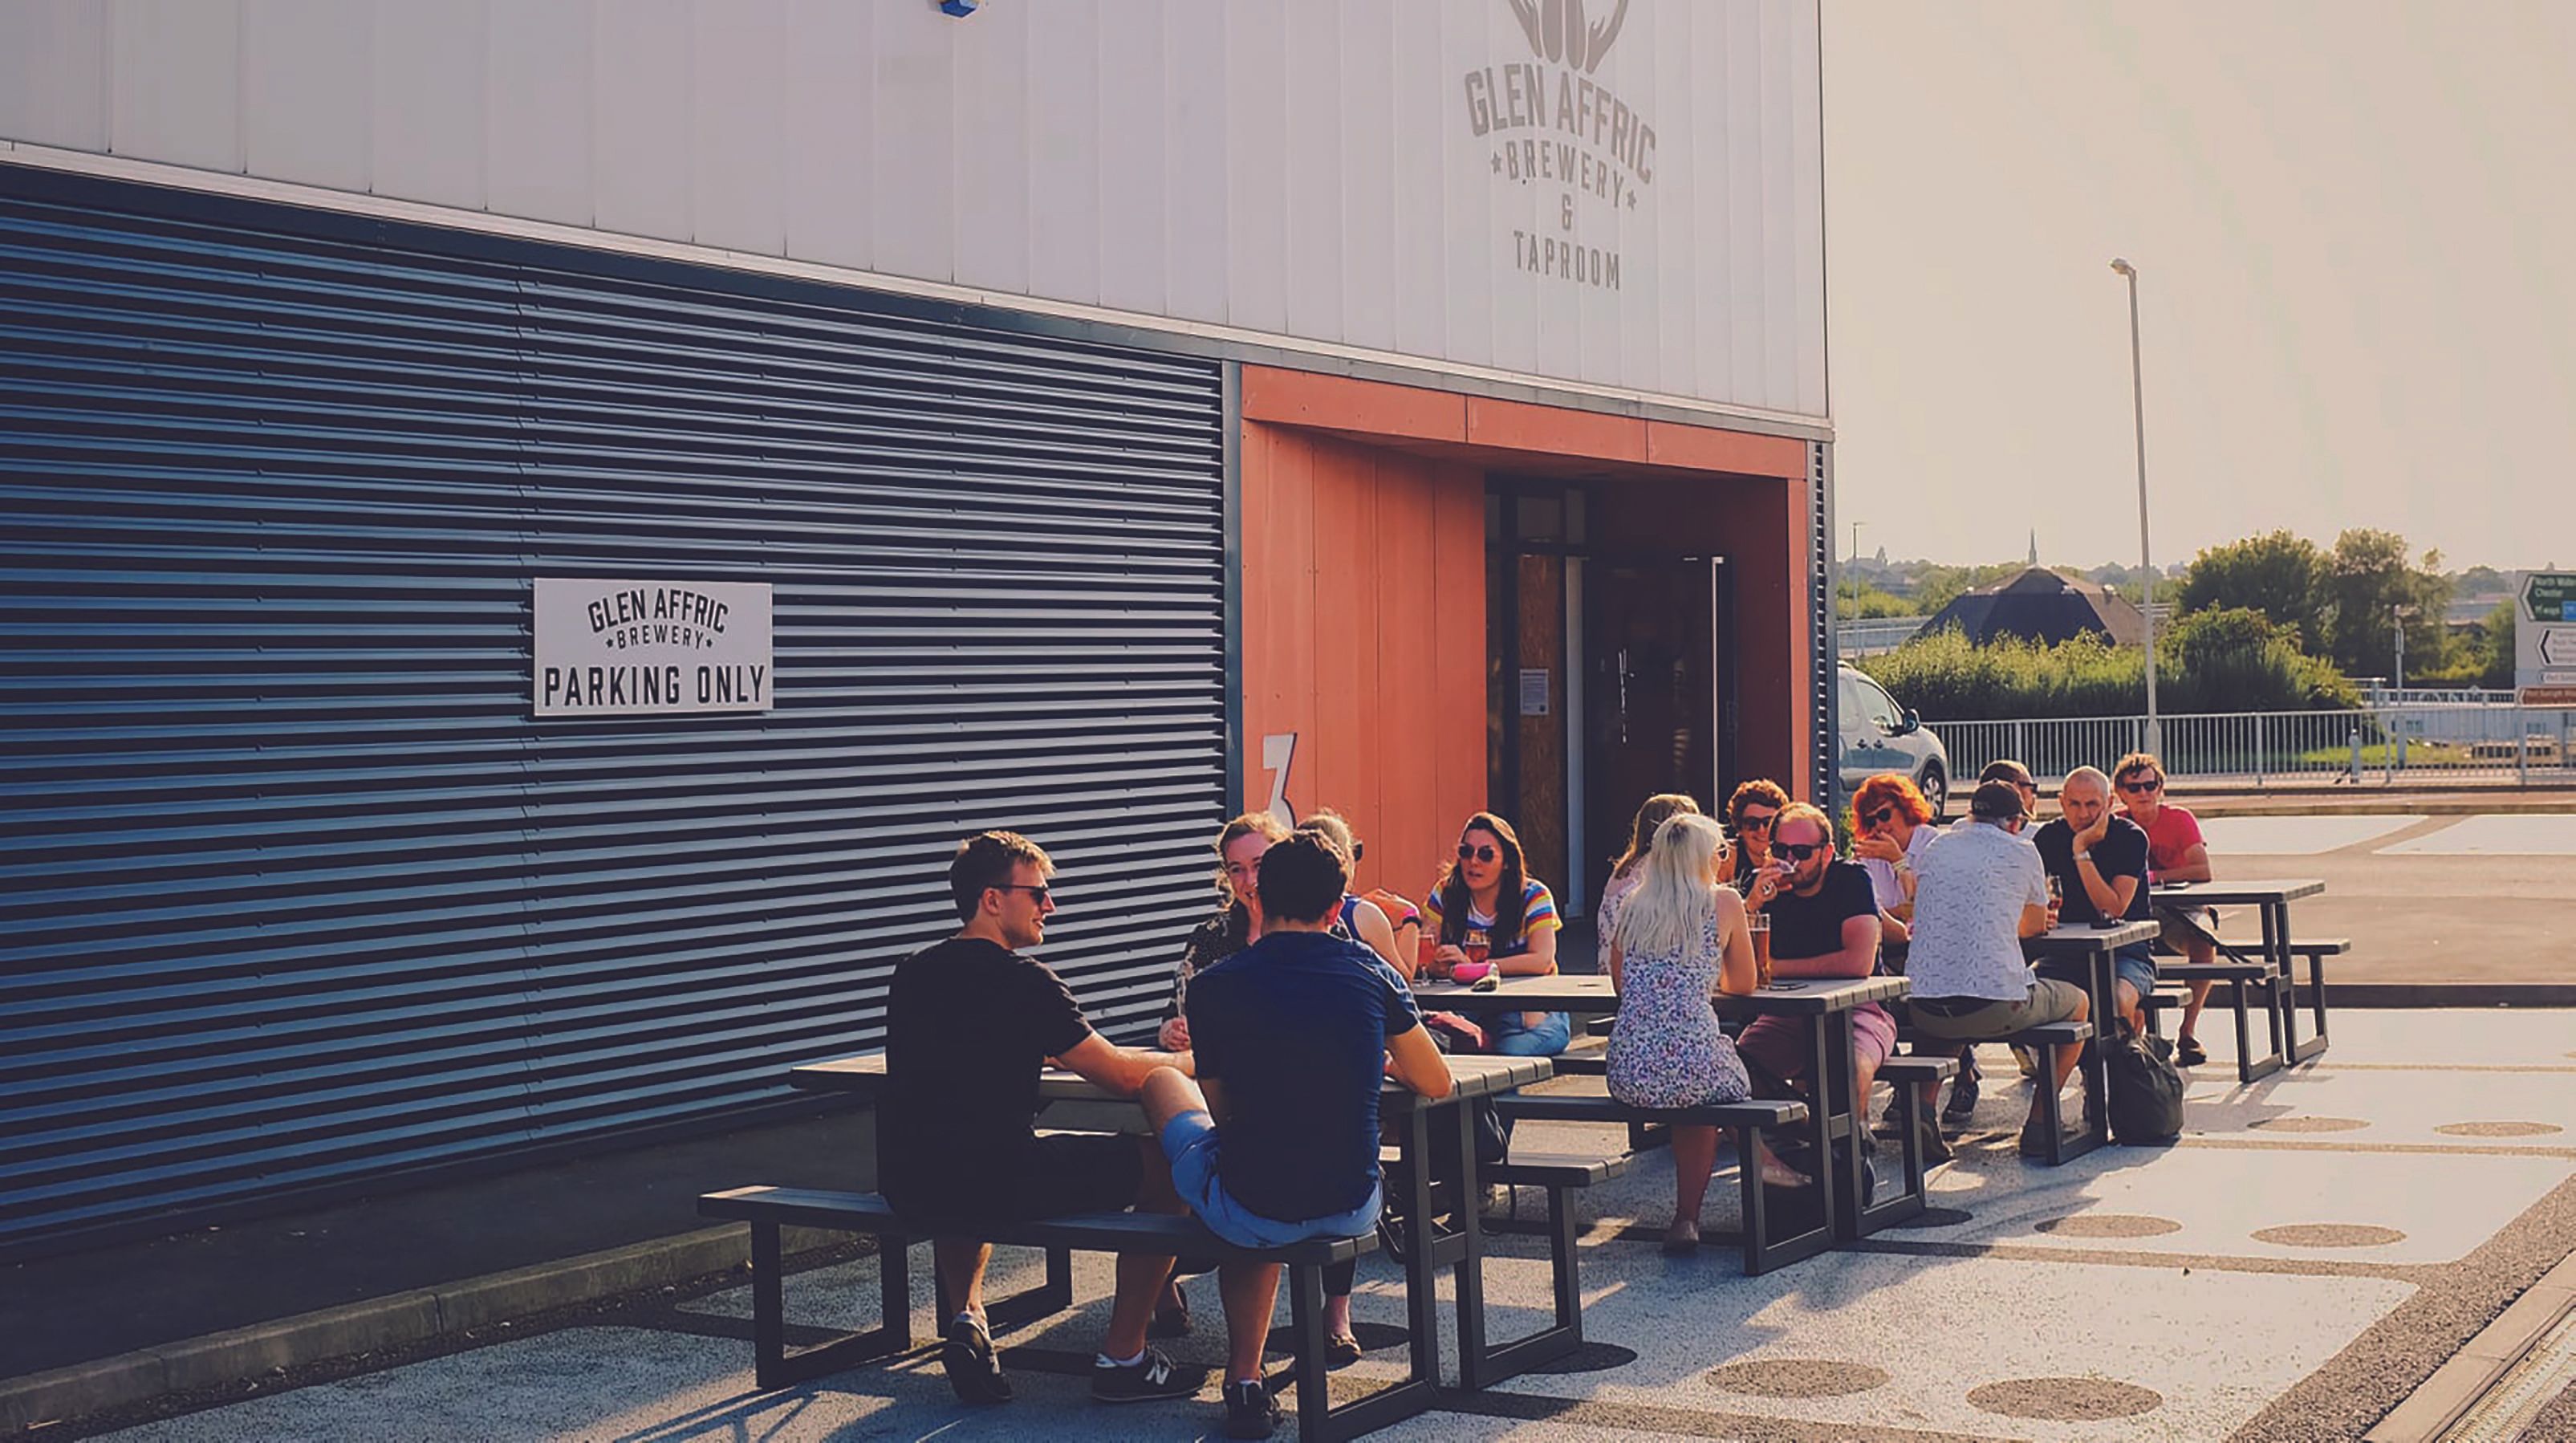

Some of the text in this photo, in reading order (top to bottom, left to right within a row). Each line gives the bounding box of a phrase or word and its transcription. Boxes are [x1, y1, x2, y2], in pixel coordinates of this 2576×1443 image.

[1465, 63, 1656, 185] GLEN AFFRIC
[1505, 139, 1624, 209] BREWERY
[1562, 193, 1573, 231] &
[1514, 230, 1619, 291] TAPROOM
[587, 588, 729, 633] GLEN AFFRIC
[616, 624, 704, 649] BREWERY
[545, 665, 765, 707] PARKING ONLY
